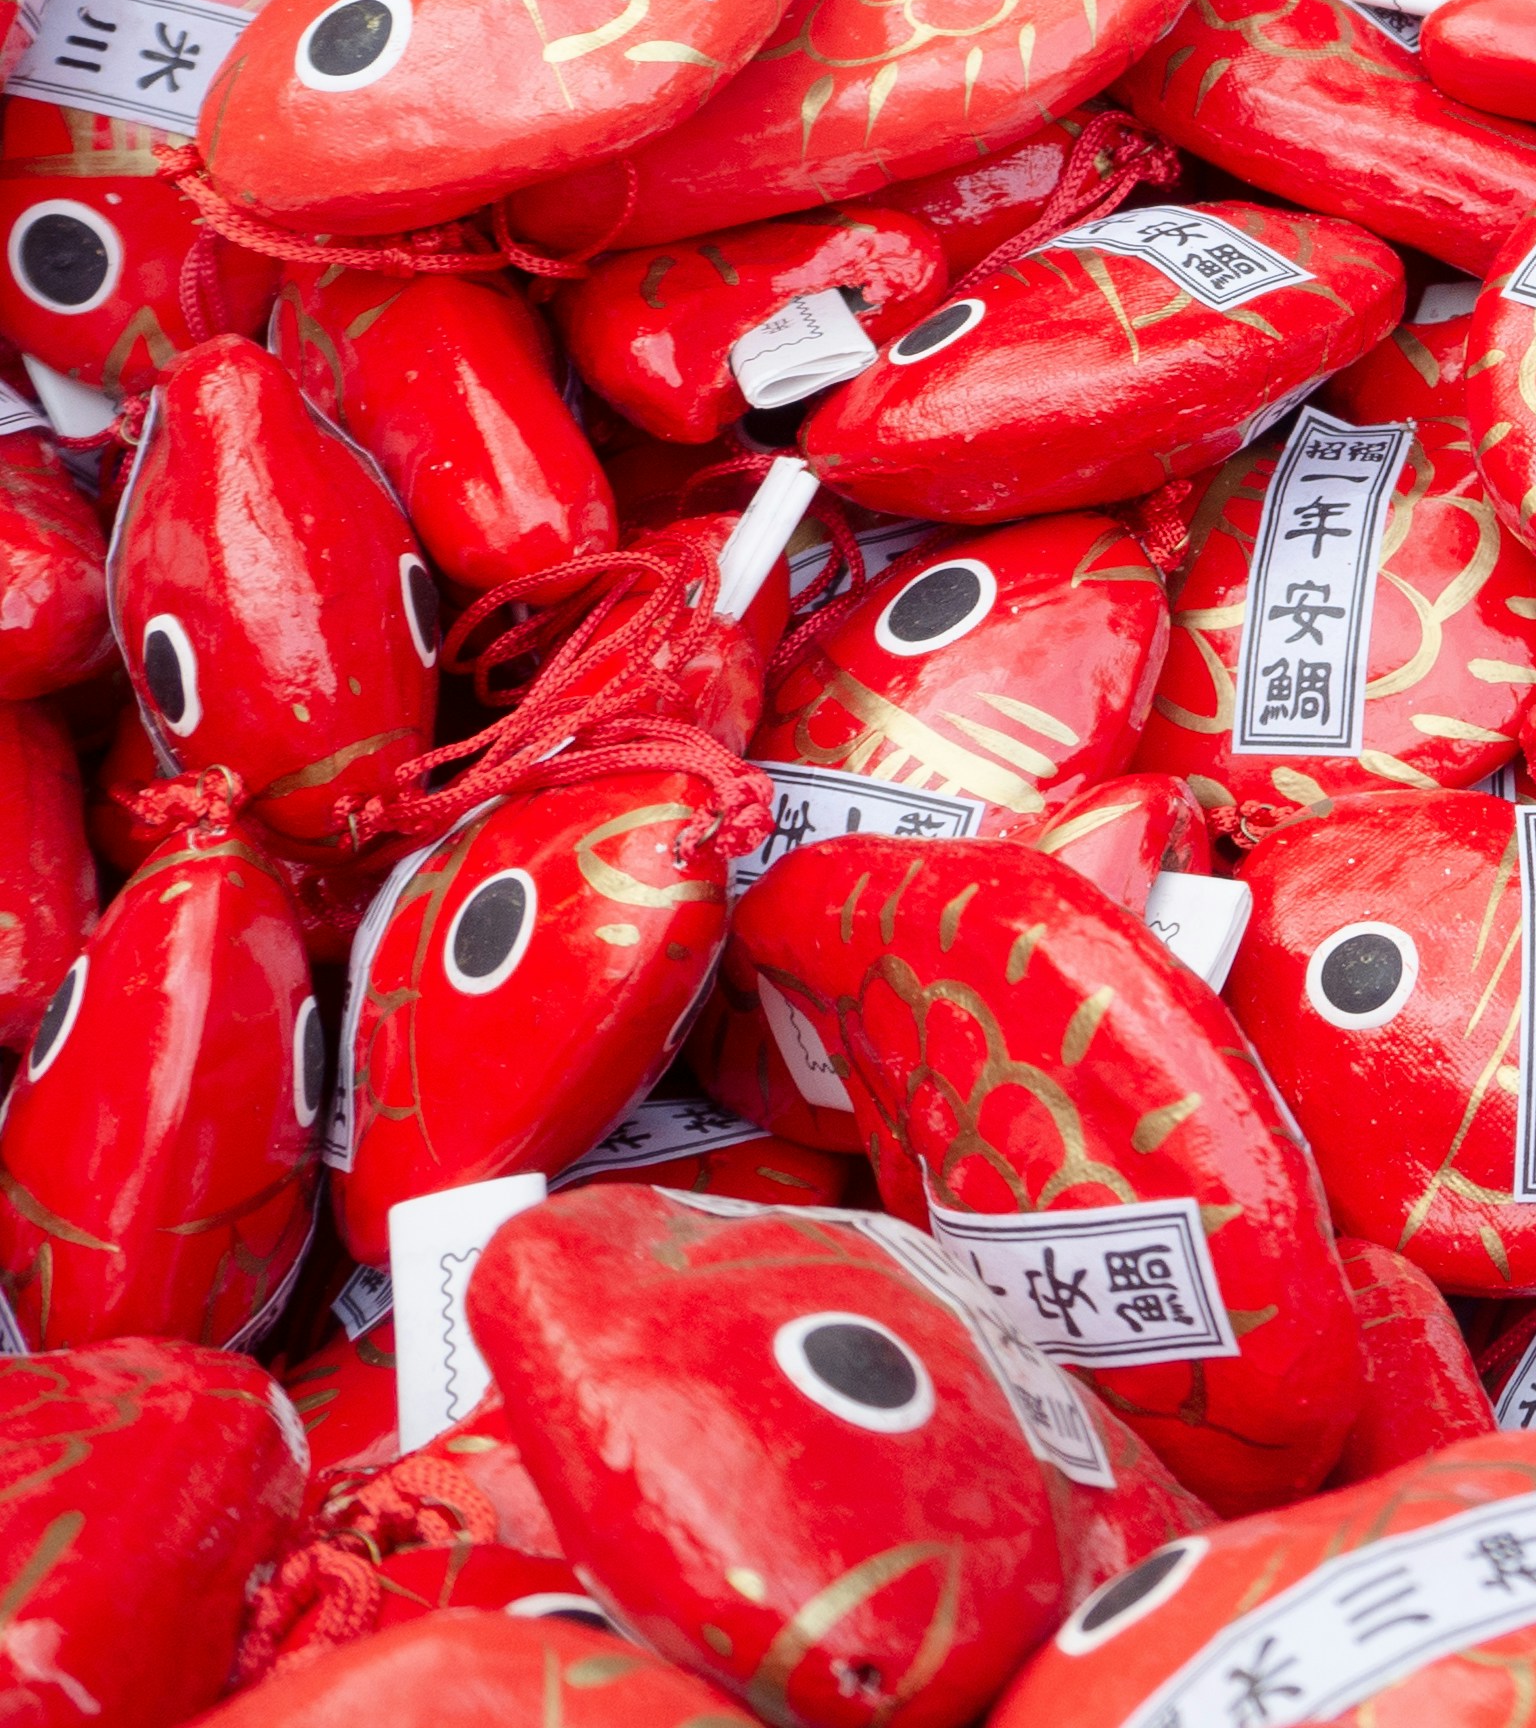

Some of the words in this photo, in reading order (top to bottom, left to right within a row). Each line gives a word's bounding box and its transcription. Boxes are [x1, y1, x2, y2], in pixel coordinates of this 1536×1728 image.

[1305, 437, 1389, 464] 招福
[1258, 472, 1367, 729] 一年安鯛
